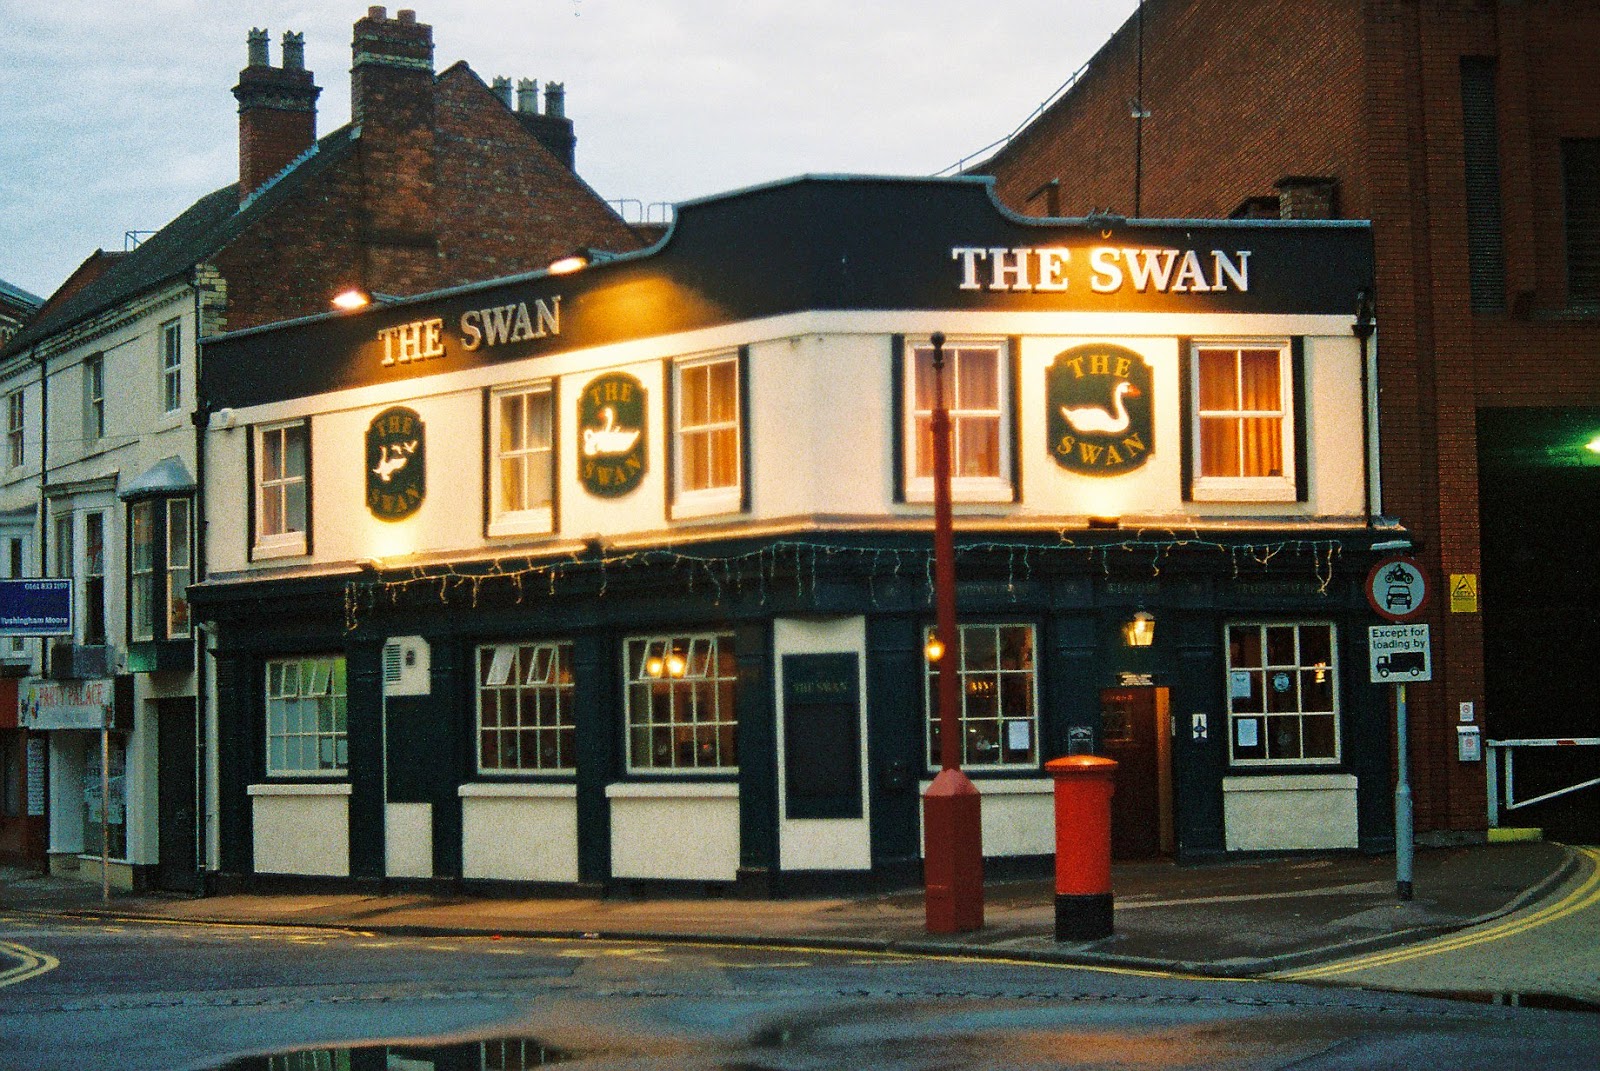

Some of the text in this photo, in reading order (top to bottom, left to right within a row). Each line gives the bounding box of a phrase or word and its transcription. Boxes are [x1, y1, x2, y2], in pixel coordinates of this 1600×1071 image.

[952, 247, 1251, 293] THE SWAN
[378, 295, 562, 367] THE SWAN
[1067, 354, 1132, 379] THE
[589, 382, 632, 405] THE
[376, 414, 413, 438] THE
[1057, 432, 1146, 466] SWAN
[585, 454, 642, 487] SWAN
[1, 616, 68, 625] Tushingham Moore
[1372, 627, 1425, 639] Except for
[1373, 638, 1426, 649] loading by
[67, 683, 104, 706] PALACE
